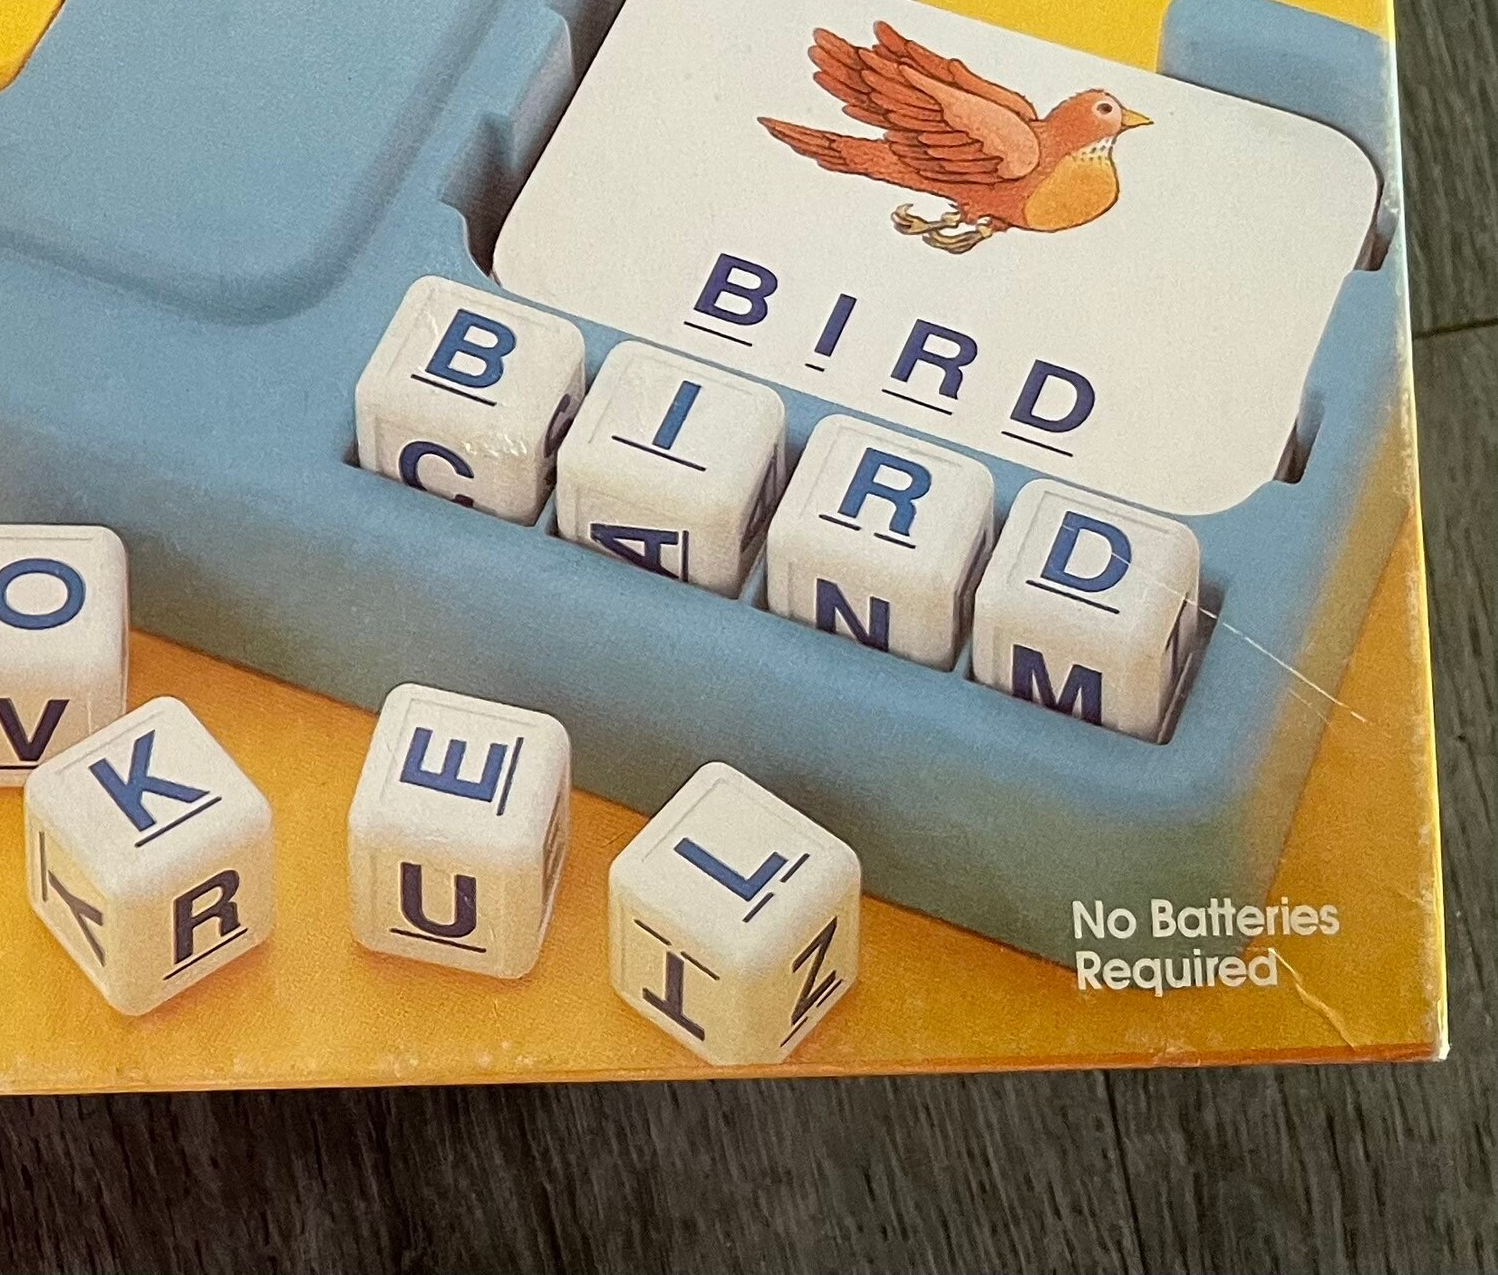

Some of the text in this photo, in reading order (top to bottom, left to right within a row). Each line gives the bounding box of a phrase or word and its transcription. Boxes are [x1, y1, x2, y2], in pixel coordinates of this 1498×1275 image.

[425, 308, 516, 389] B
[652, 379, 702, 451] I
[836, 446, 933, 537] R
[1039, 510, 1133, 593] D
[814, 577, 890, 652] N
[1011, 643, 1103, 725] M
[87, 728, 211, 833] K
[399, 726, 509, 803] E
[399, 861, 477, 939] U
[673, 837, 789, 902] L
[47, 869, 105, 967] Y
[173, 868, 242, 965] R
[1071, 896, 1340, 940] No Batteries
[1075, 946, 1278, 998] Required
